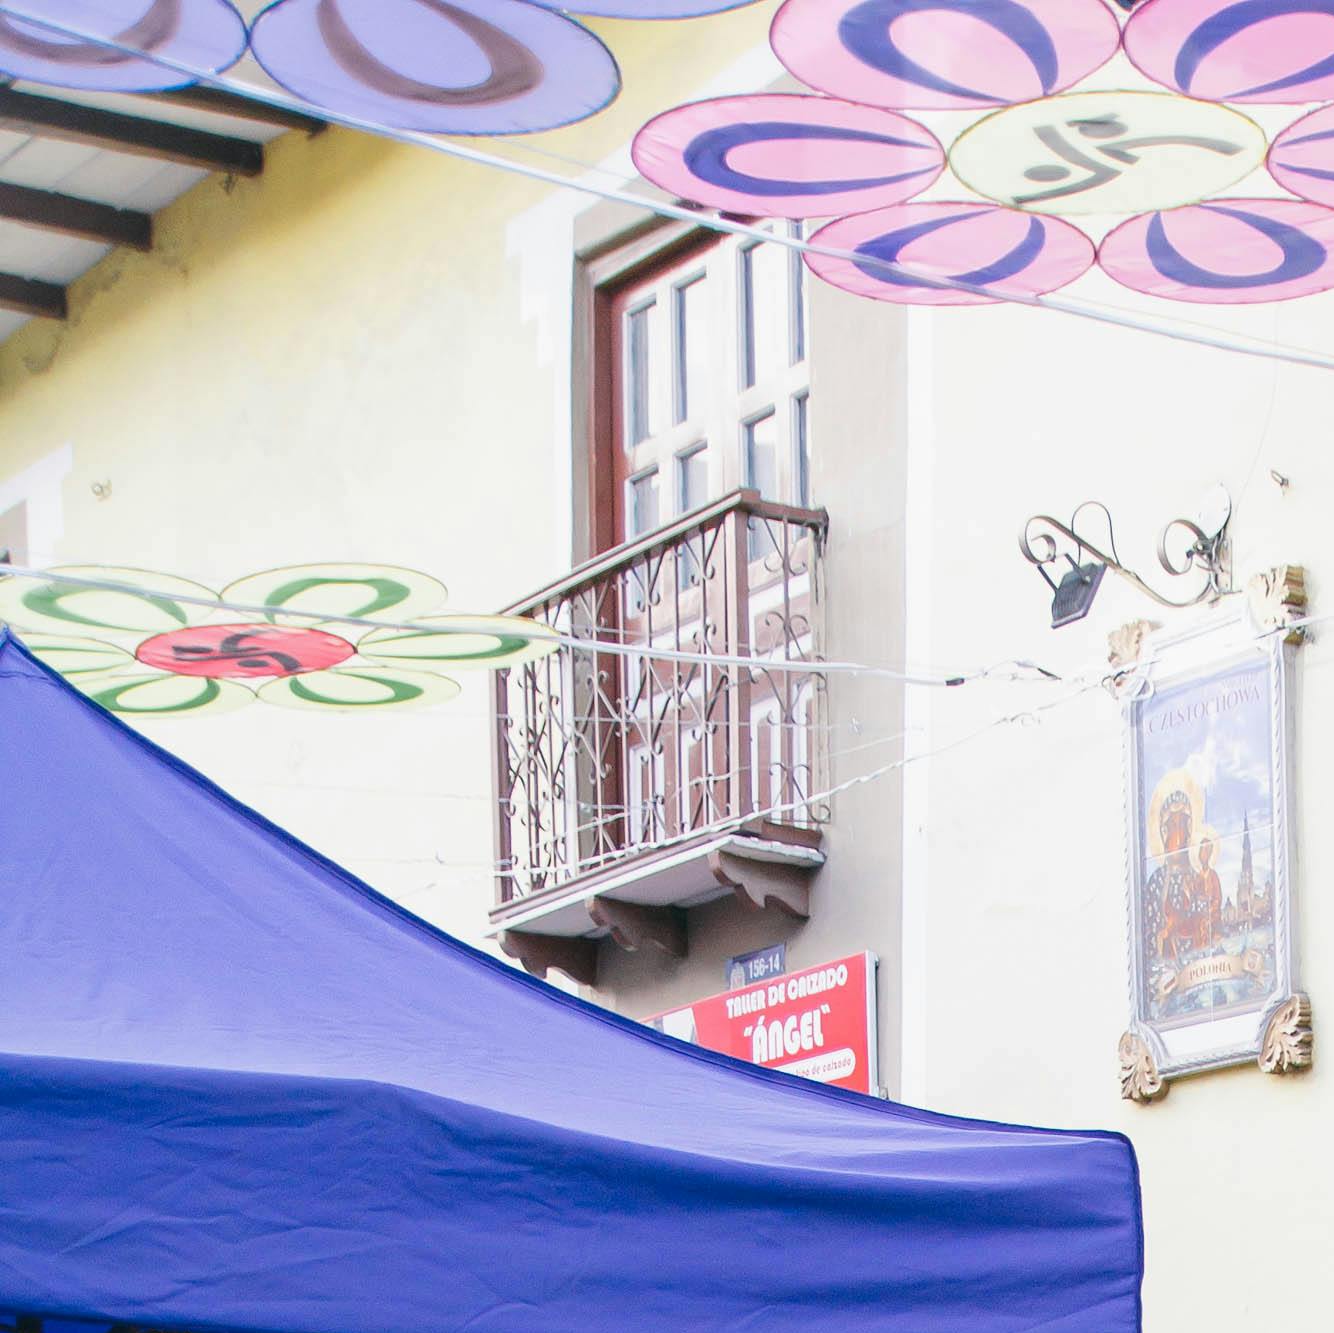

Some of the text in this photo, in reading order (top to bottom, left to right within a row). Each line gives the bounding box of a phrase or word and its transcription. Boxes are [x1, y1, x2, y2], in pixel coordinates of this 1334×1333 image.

[749, 953, 780, 979] 156-14
[726, 964, 848, 1019] TALLER DE CALZADO
